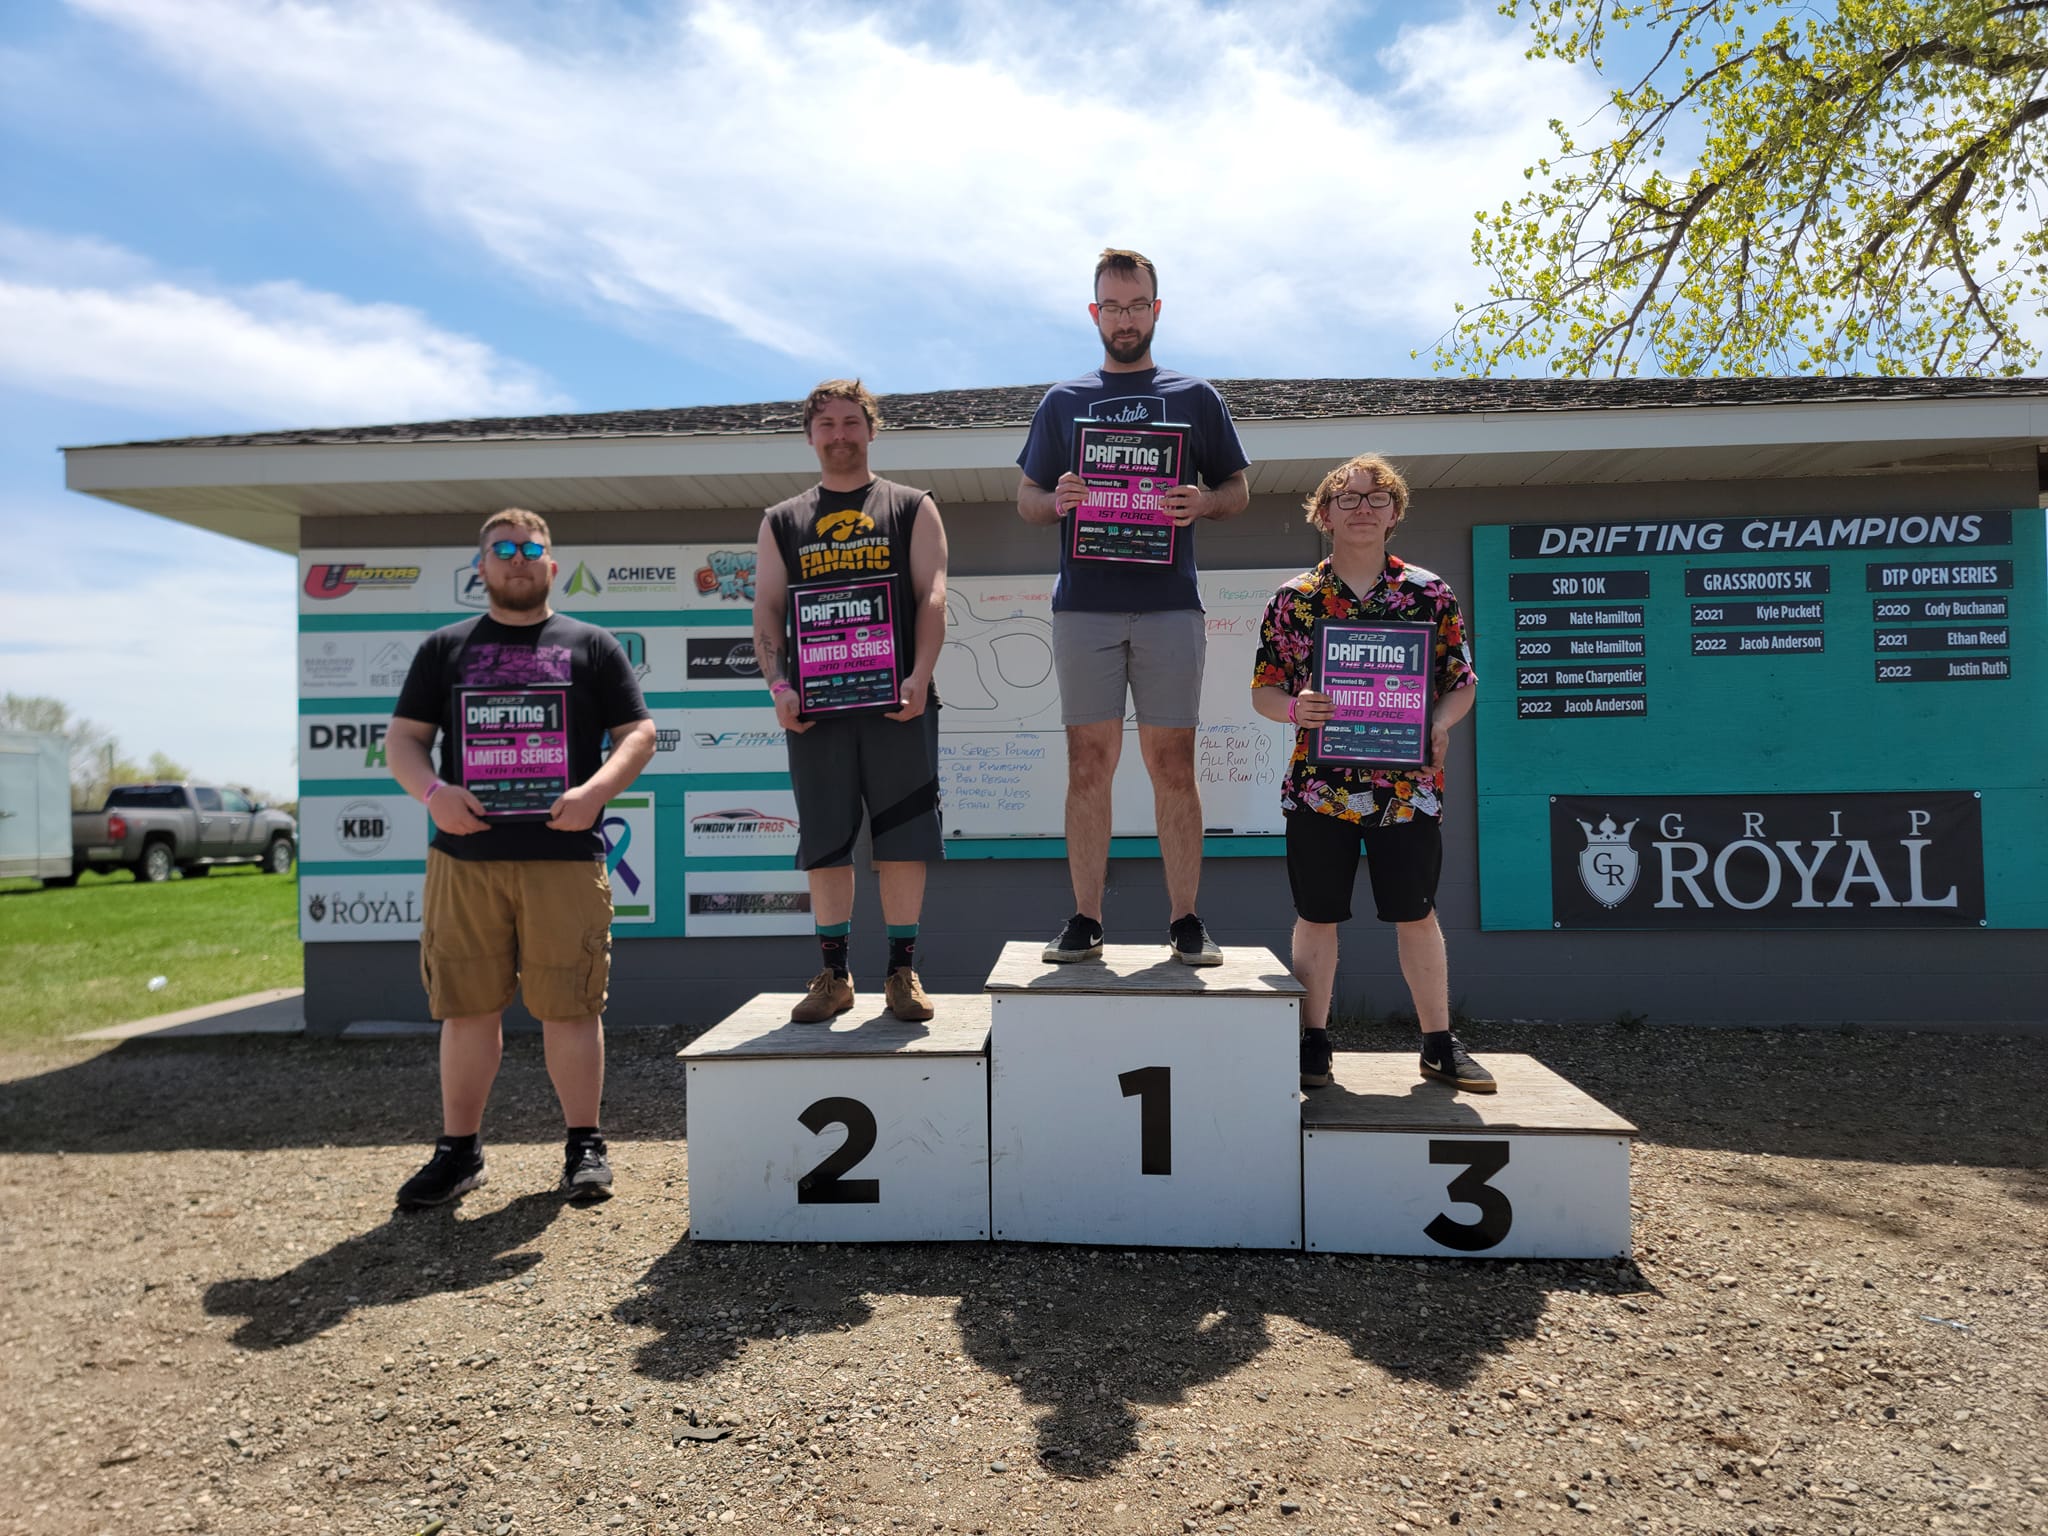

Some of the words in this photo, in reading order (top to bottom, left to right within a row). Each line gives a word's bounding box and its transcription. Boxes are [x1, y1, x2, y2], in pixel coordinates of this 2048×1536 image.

[1105, 435, 1142, 444] 2023
[1085, 444, 1160, 466] DRIFTING
[1163, 446, 1173, 474] 1
[1119, 465, 1157, 473] PLAINS
[1131, 492, 1171, 510] SERIE
[1098, 510, 1115, 518] 1ST
[1120, 511, 1155, 520] PLACE
[1538, 523, 1725, 554] DRIFTING
[1741, 515, 1983, 549] CHAMPIONS
[798, 542, 827, 556] IOWA
[831, 537, 890, 550] HAWKEYES
[799, 545, 890, 579] FANATIC
[345, 567, 421, 579] MOTORS
[607, 567, 676, 581] ACHIEVE
[1703, 571, 1791, 591] GRASSROOTS
[1794, 571, 1812, 589] 5K
[1882, 568, 1908, 586] DTP
[1912, 567, 1949, 585] OPEN
[1952, 566, 1998, 584] SERIES
[1552, 578, 1578, 595] SRD
[1581, 577, 1606, 594] 10K
[818, 591, 852, 601] 2023
[800, 599, 872, 623] DRIFTING
[874, 594, 884, 620] 1
[1694, 609, 1724, 621] 2021
[1756, 606, 1779, 621] Kyle
[1781, 604, 1821, 618] Puckett
[1877, 604, 1911, 616] 2020
[1925, 602, 1951, 618] Cody
[1953, 601, 2005, 615] Buchanan
[1518, 613, 1547, 625] 2019
[1569, 611, 1593, 625] Nate
[1595, 610, 1641, 624] Hamilton
[1348, 633, 1387, 641] 2023
[1695, 639, 1727, 651] 2022
[1739, 636, 1769, 650] Jacob
[1771, 635, 1821, 649] Anderson
[1878, 634, 1908, 646] 2021
[1947, 632, 1978, 645] Ethan
[1979, 630, 2006, 644] Reed
[803, 644, 848, 664] LIMITED
[851, 640, 891, 658] SERIES
[1519, 643, 1551, 654] 2020
[1570, 641, 1594, 654] Nate
[1596, 639, 1642, 653] Hamilton
[690, 656, 722, 666] AL'S
[725, 656, 758, 666] DRIF
[1328, 643, 1406, 663] DRIFTING
[1409, 643, 1419, 671] 1
[1363, 662, 1405, 670] PLAINS
[1879, 666, 1912, 678] 2022
[1948, 662, 1980, 676] Justin
[1982, 661, 2007, 675] Ruth
[1520, 672, 1549, 684] 2021
[1555, 671, 1584, 684] Rome
[1586, 669, 1643, 686] Charpentier
[486, 696, 525, 705] 2023
[1378, 691, 1421, 709] SERIES
[1521, 702, 1552, 713] 2022
[1564, 699, 1593, 713] Jacob
[1595, 698, 1644, 711] Anderson
[467, 706, 545, 725] DRIFTING
[547, 703, 558, 729] 1
[1340, 709, 1364, 717] 3RD
[1369, 710, 1405, 719] PLACE
[309, 724, 388, 749] DRIF
[656, 730, 680, 740] STOM
[1200, 736, 1221, 749] ALL
[1226, 737, 1250, 750] RUN
[364, 743, 387, 768] H
[467, 750, 517, 767] LIMITED
[521, 748, 564, 765] SERIES
[961, 742, 1000, 757] SERIES
[1200, 752, 1224, 766] ALL
[1227, 752, 1248, 766] RUN
[1200, 768, 1224, 782] ALL
[1229, 767, 1252, 782] RUN
[343, 819, 384, 839] KBD
[693, 822, 736, 833] WINDOW
[737, 822, 758, 833] TINT
[757, 822, 785, 832] PROS
[1659, 810, 1931, 840] GRIP
[1652, 838, 1958, 910] ROYAL
[331, 900, 421, 924] ROYAL
[1118, 1066, 1171, 1176] 1
[797, 1097, 880, 1204] 2
[1423, 1140, 1512, 1252] 3
